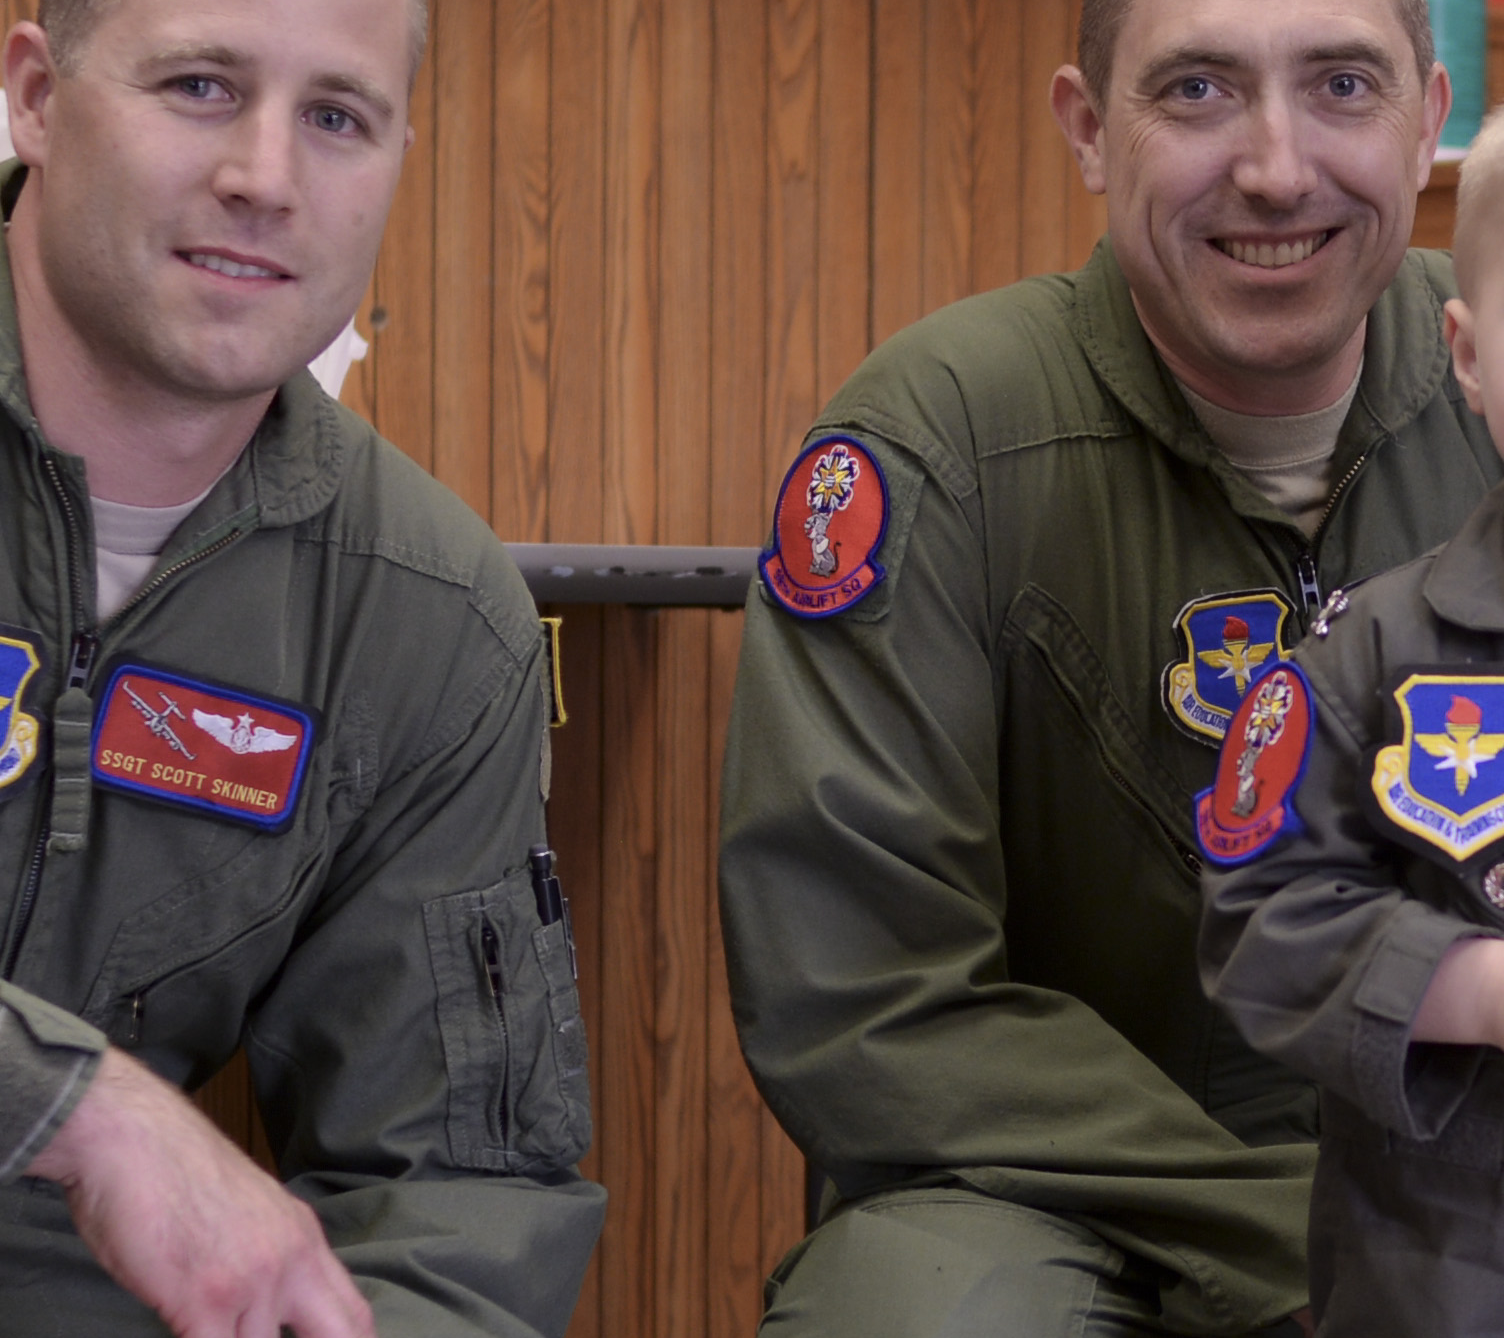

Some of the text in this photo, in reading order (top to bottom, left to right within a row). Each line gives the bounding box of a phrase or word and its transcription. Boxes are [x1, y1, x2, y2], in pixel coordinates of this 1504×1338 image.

[100, 749, 278, 810] SSGT SCOTT SKINNER
